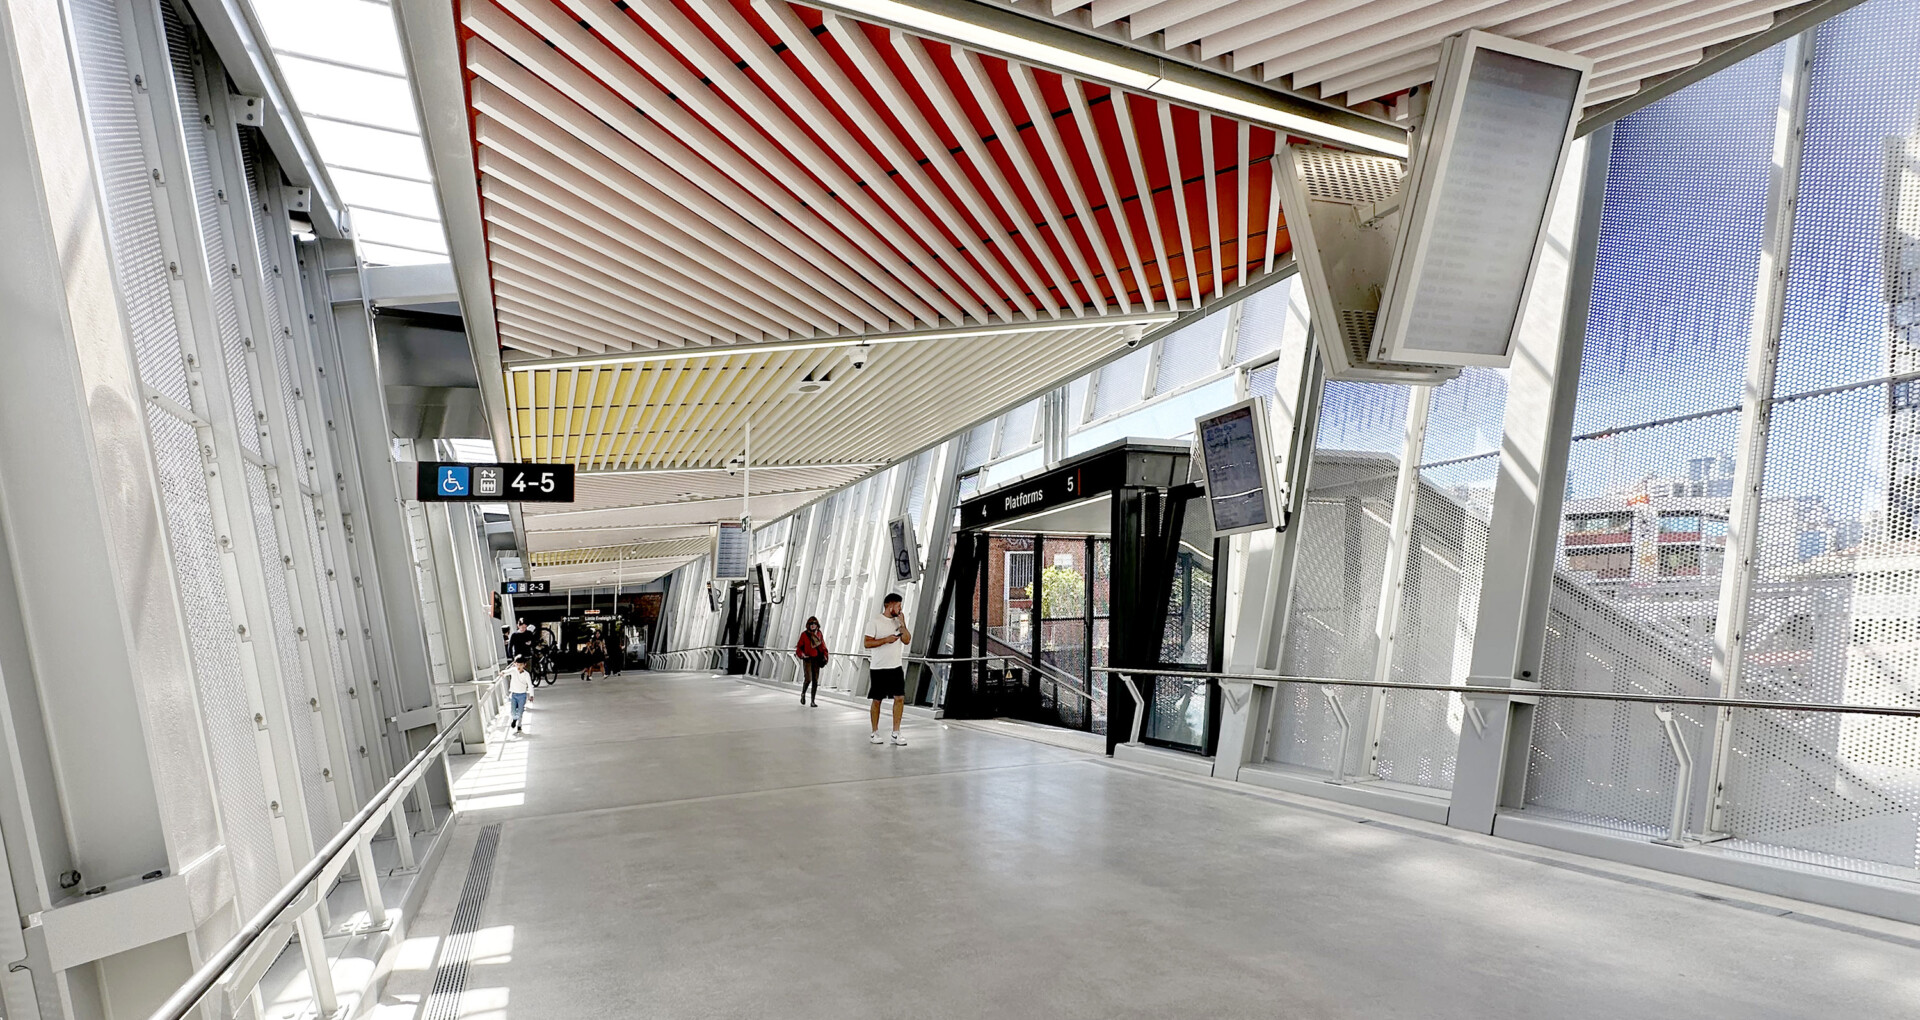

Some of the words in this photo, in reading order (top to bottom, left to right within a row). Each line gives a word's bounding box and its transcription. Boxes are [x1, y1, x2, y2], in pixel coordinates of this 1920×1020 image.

[511, 472, 555, 492] 4-5
[982, 505, 987, 517] 4
[1005, 489, 1043, 511] Platforms
[1067, 476, 1074, 492] 5
[529, 583, 544, 591] 2-3
